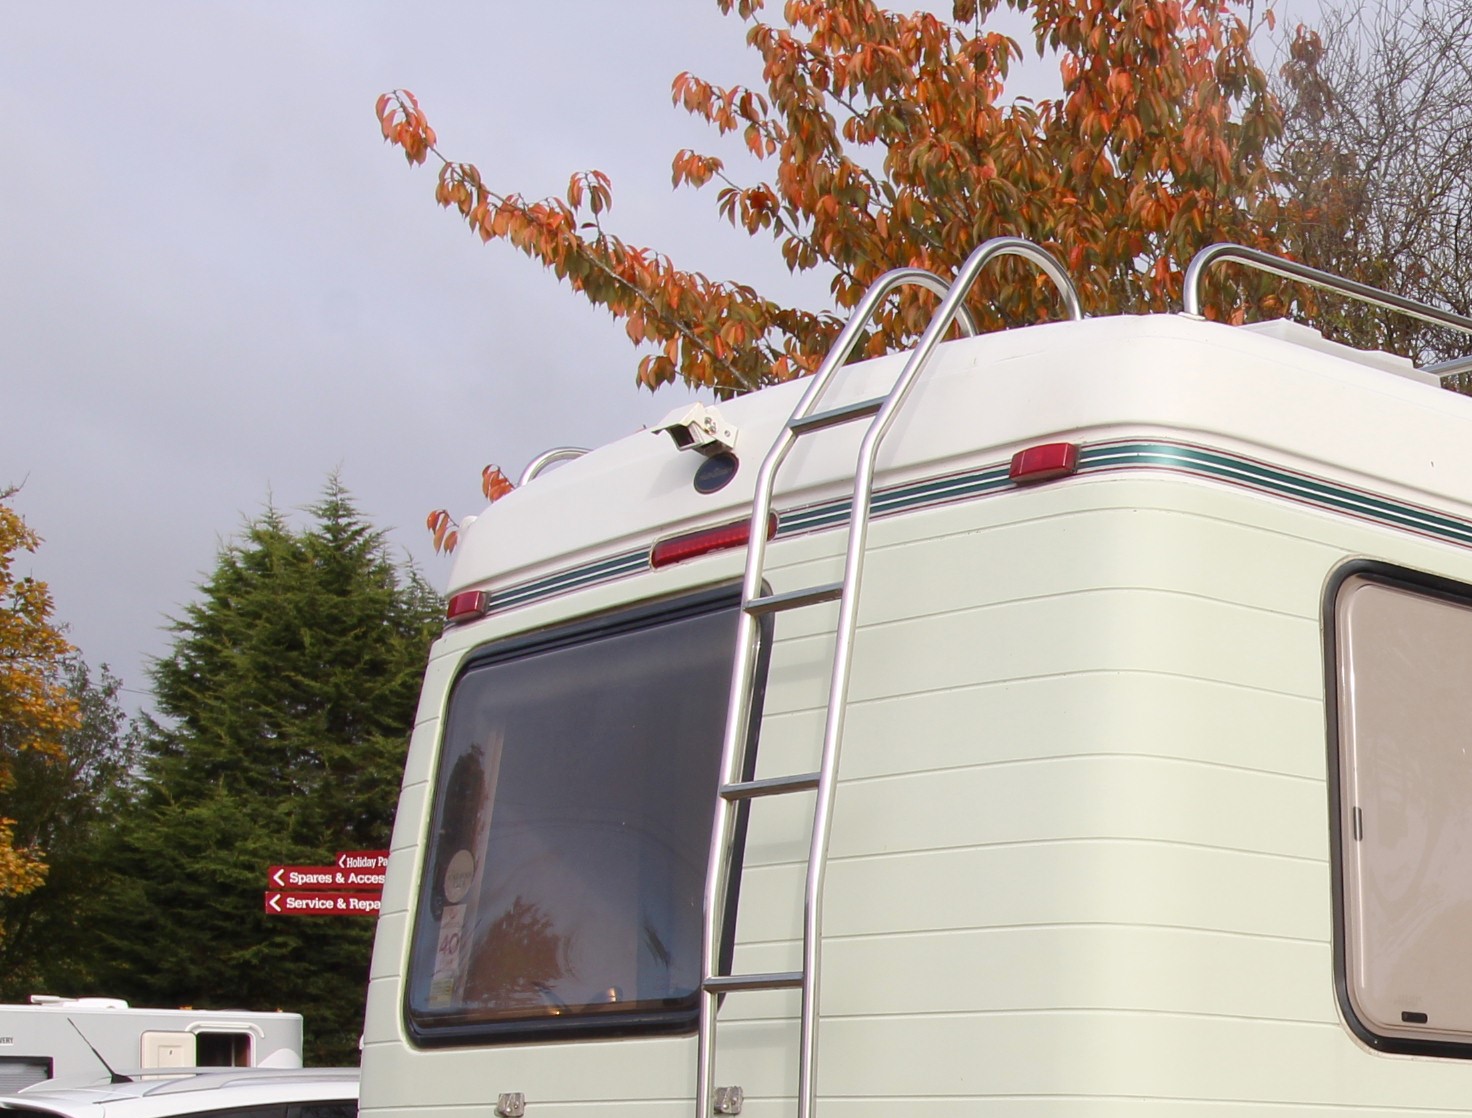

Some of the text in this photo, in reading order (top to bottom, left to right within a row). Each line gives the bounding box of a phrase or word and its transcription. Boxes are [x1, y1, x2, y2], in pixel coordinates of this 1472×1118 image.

[346, 857, 377, 869] Holiday
[289, 872, 386, 885] Spares & Acces
[286, 897, 381, 911] Service & Repa
